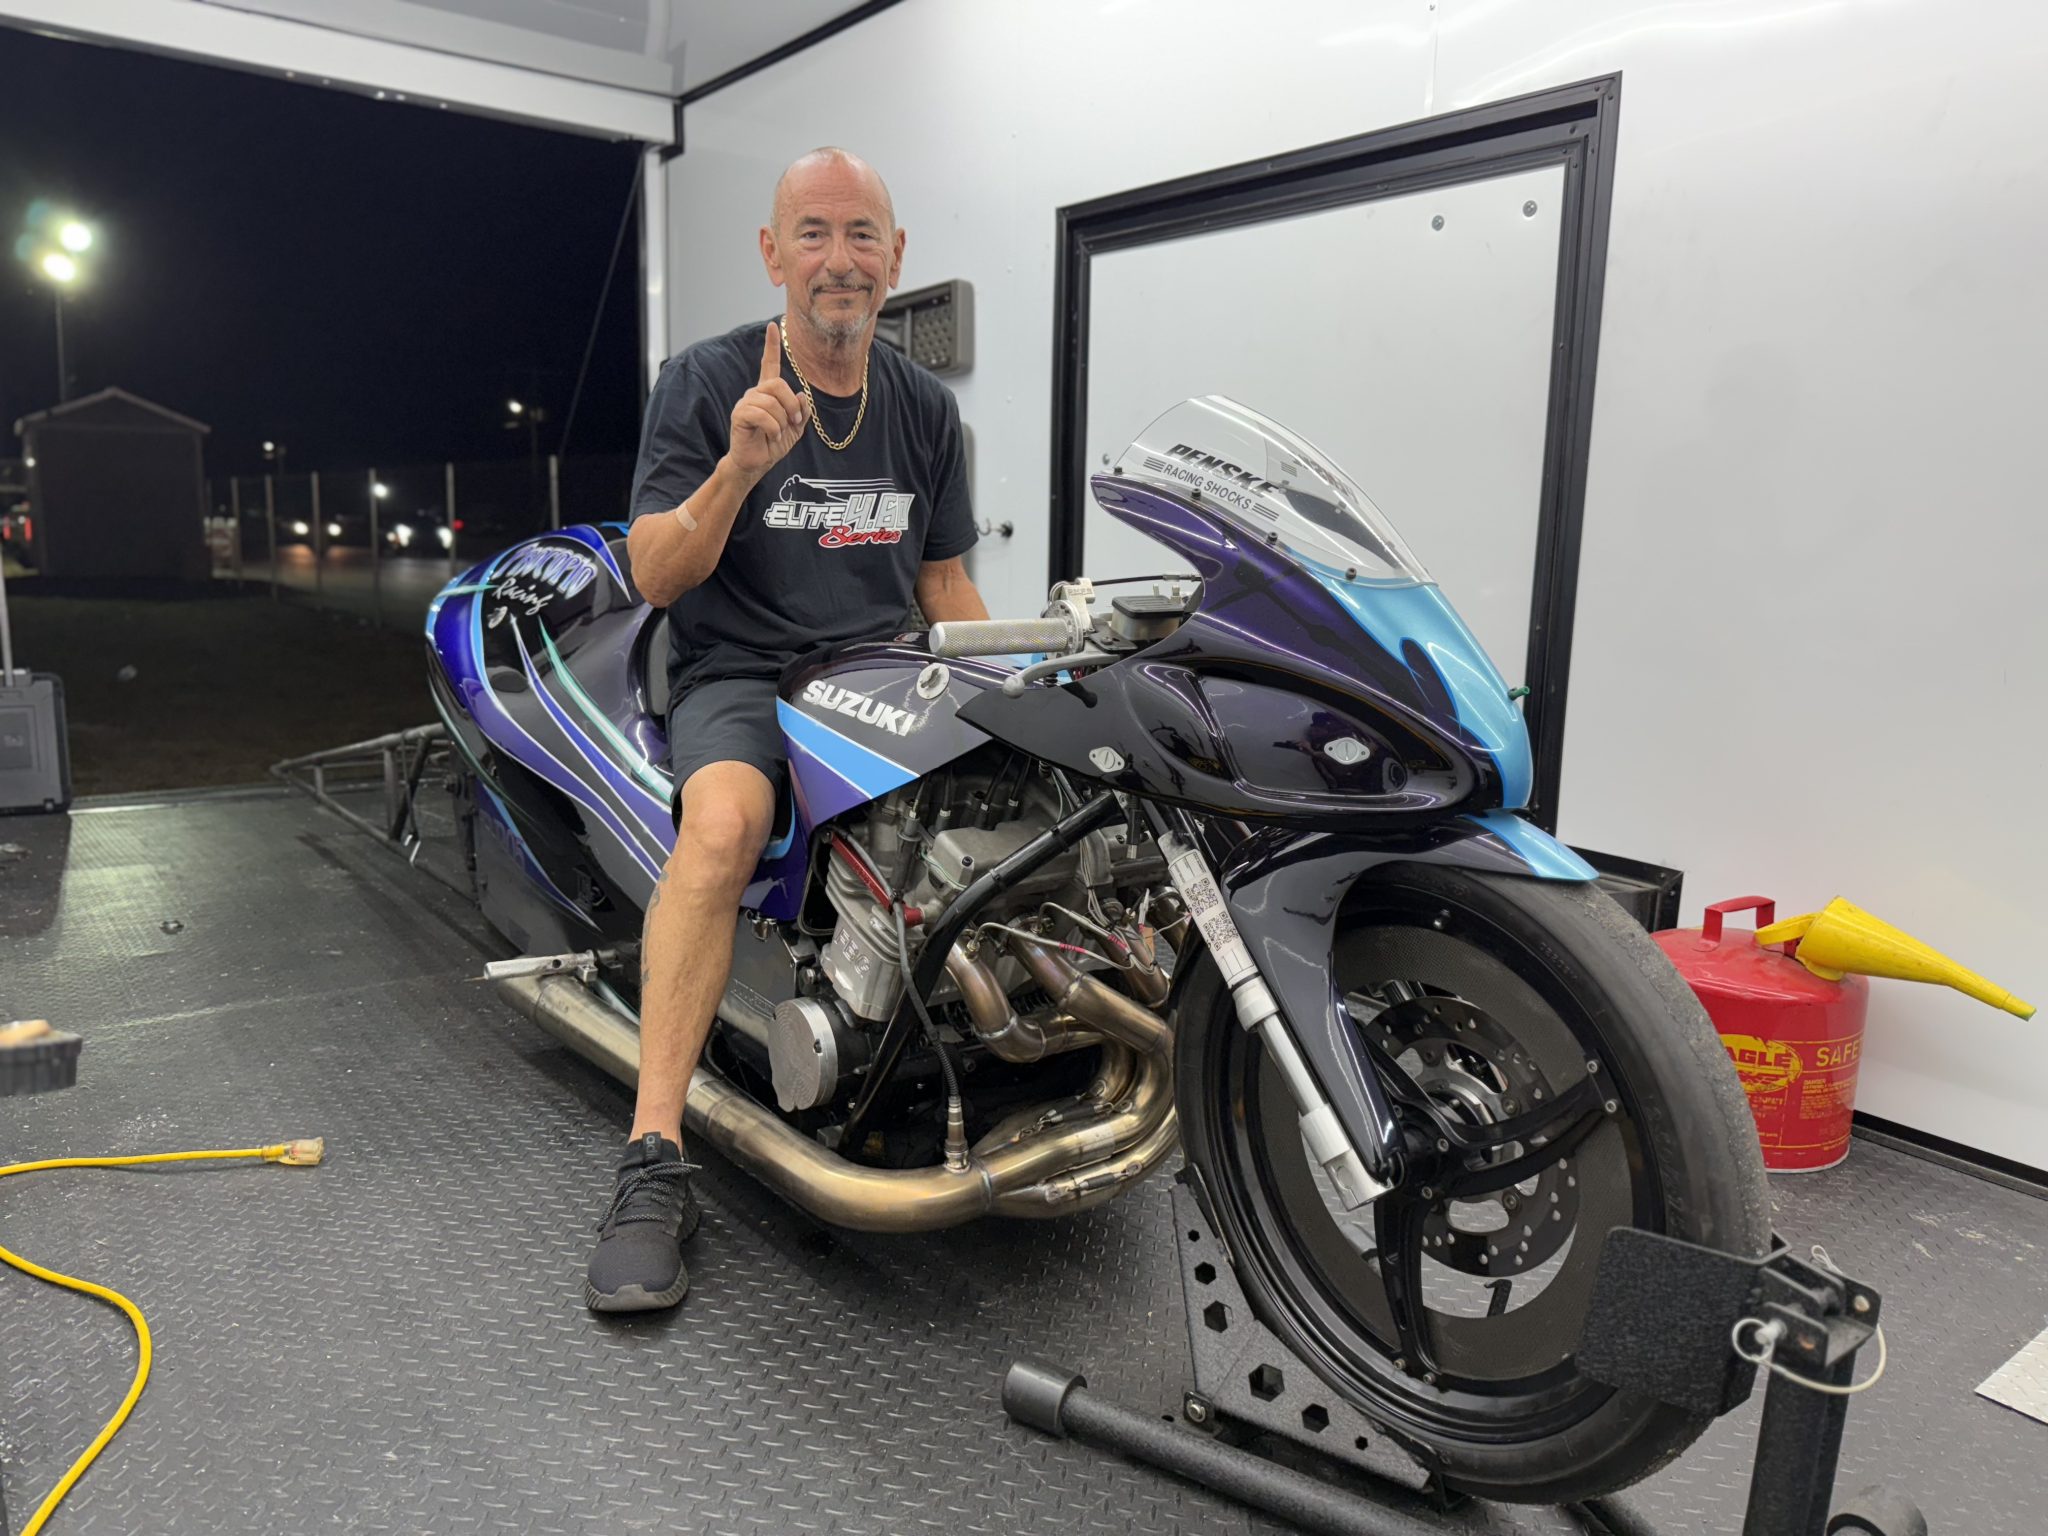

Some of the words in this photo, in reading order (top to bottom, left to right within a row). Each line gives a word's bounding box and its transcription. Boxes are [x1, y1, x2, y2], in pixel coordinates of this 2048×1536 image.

[1163, 443, 1280, 498] PENSKE
[1163, 463, 1204, 487] RACING
[1203, 480, 1252, 510] SHOCKS
[764, 502, 850, 529] ELITE
[818, 525, 902, 548] Series
[492, 577, 554, 616] Racing
[802, 679, 917, 737] SUZUKI
[1725, 1046, 1793, 1068] AGLE
[1816, 1038, 1860, 1067] SAFE
